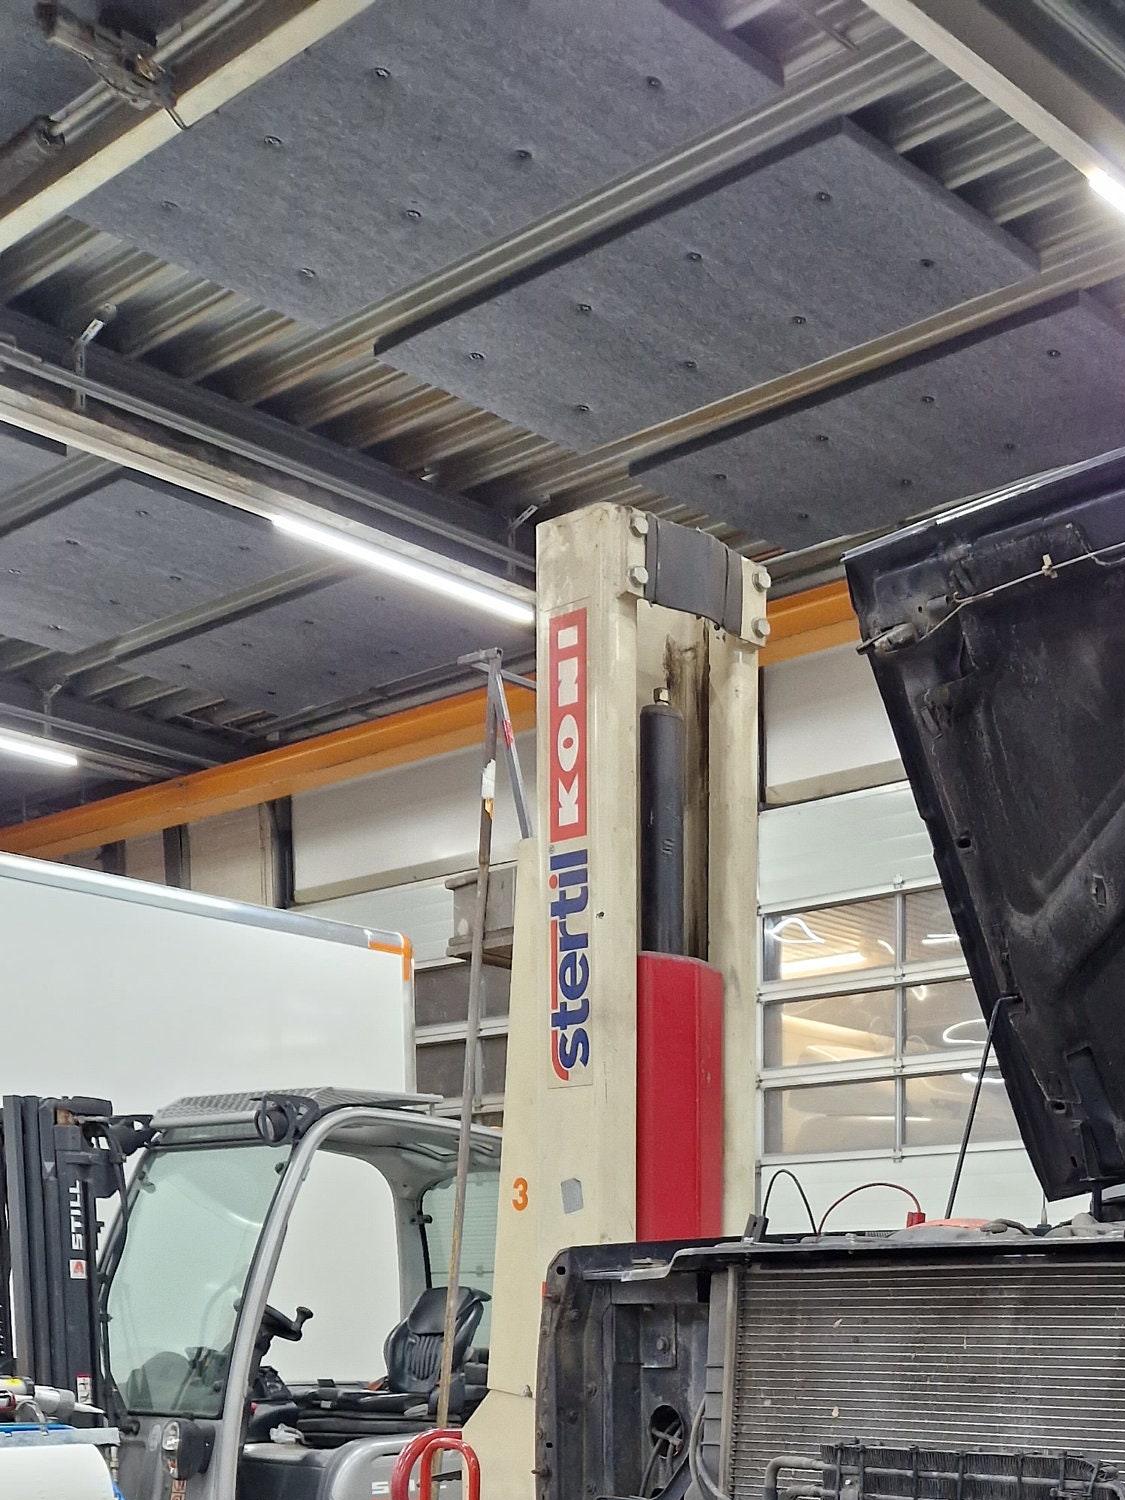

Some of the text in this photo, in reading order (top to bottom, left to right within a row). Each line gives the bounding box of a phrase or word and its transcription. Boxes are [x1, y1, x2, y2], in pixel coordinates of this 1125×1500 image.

[557, 624, 580, 828] KONI
[550, 848, 591, 1081] stertil
[69, 1180, 83, 1249] STILL
[511, 1177, 529, 1211] 3
